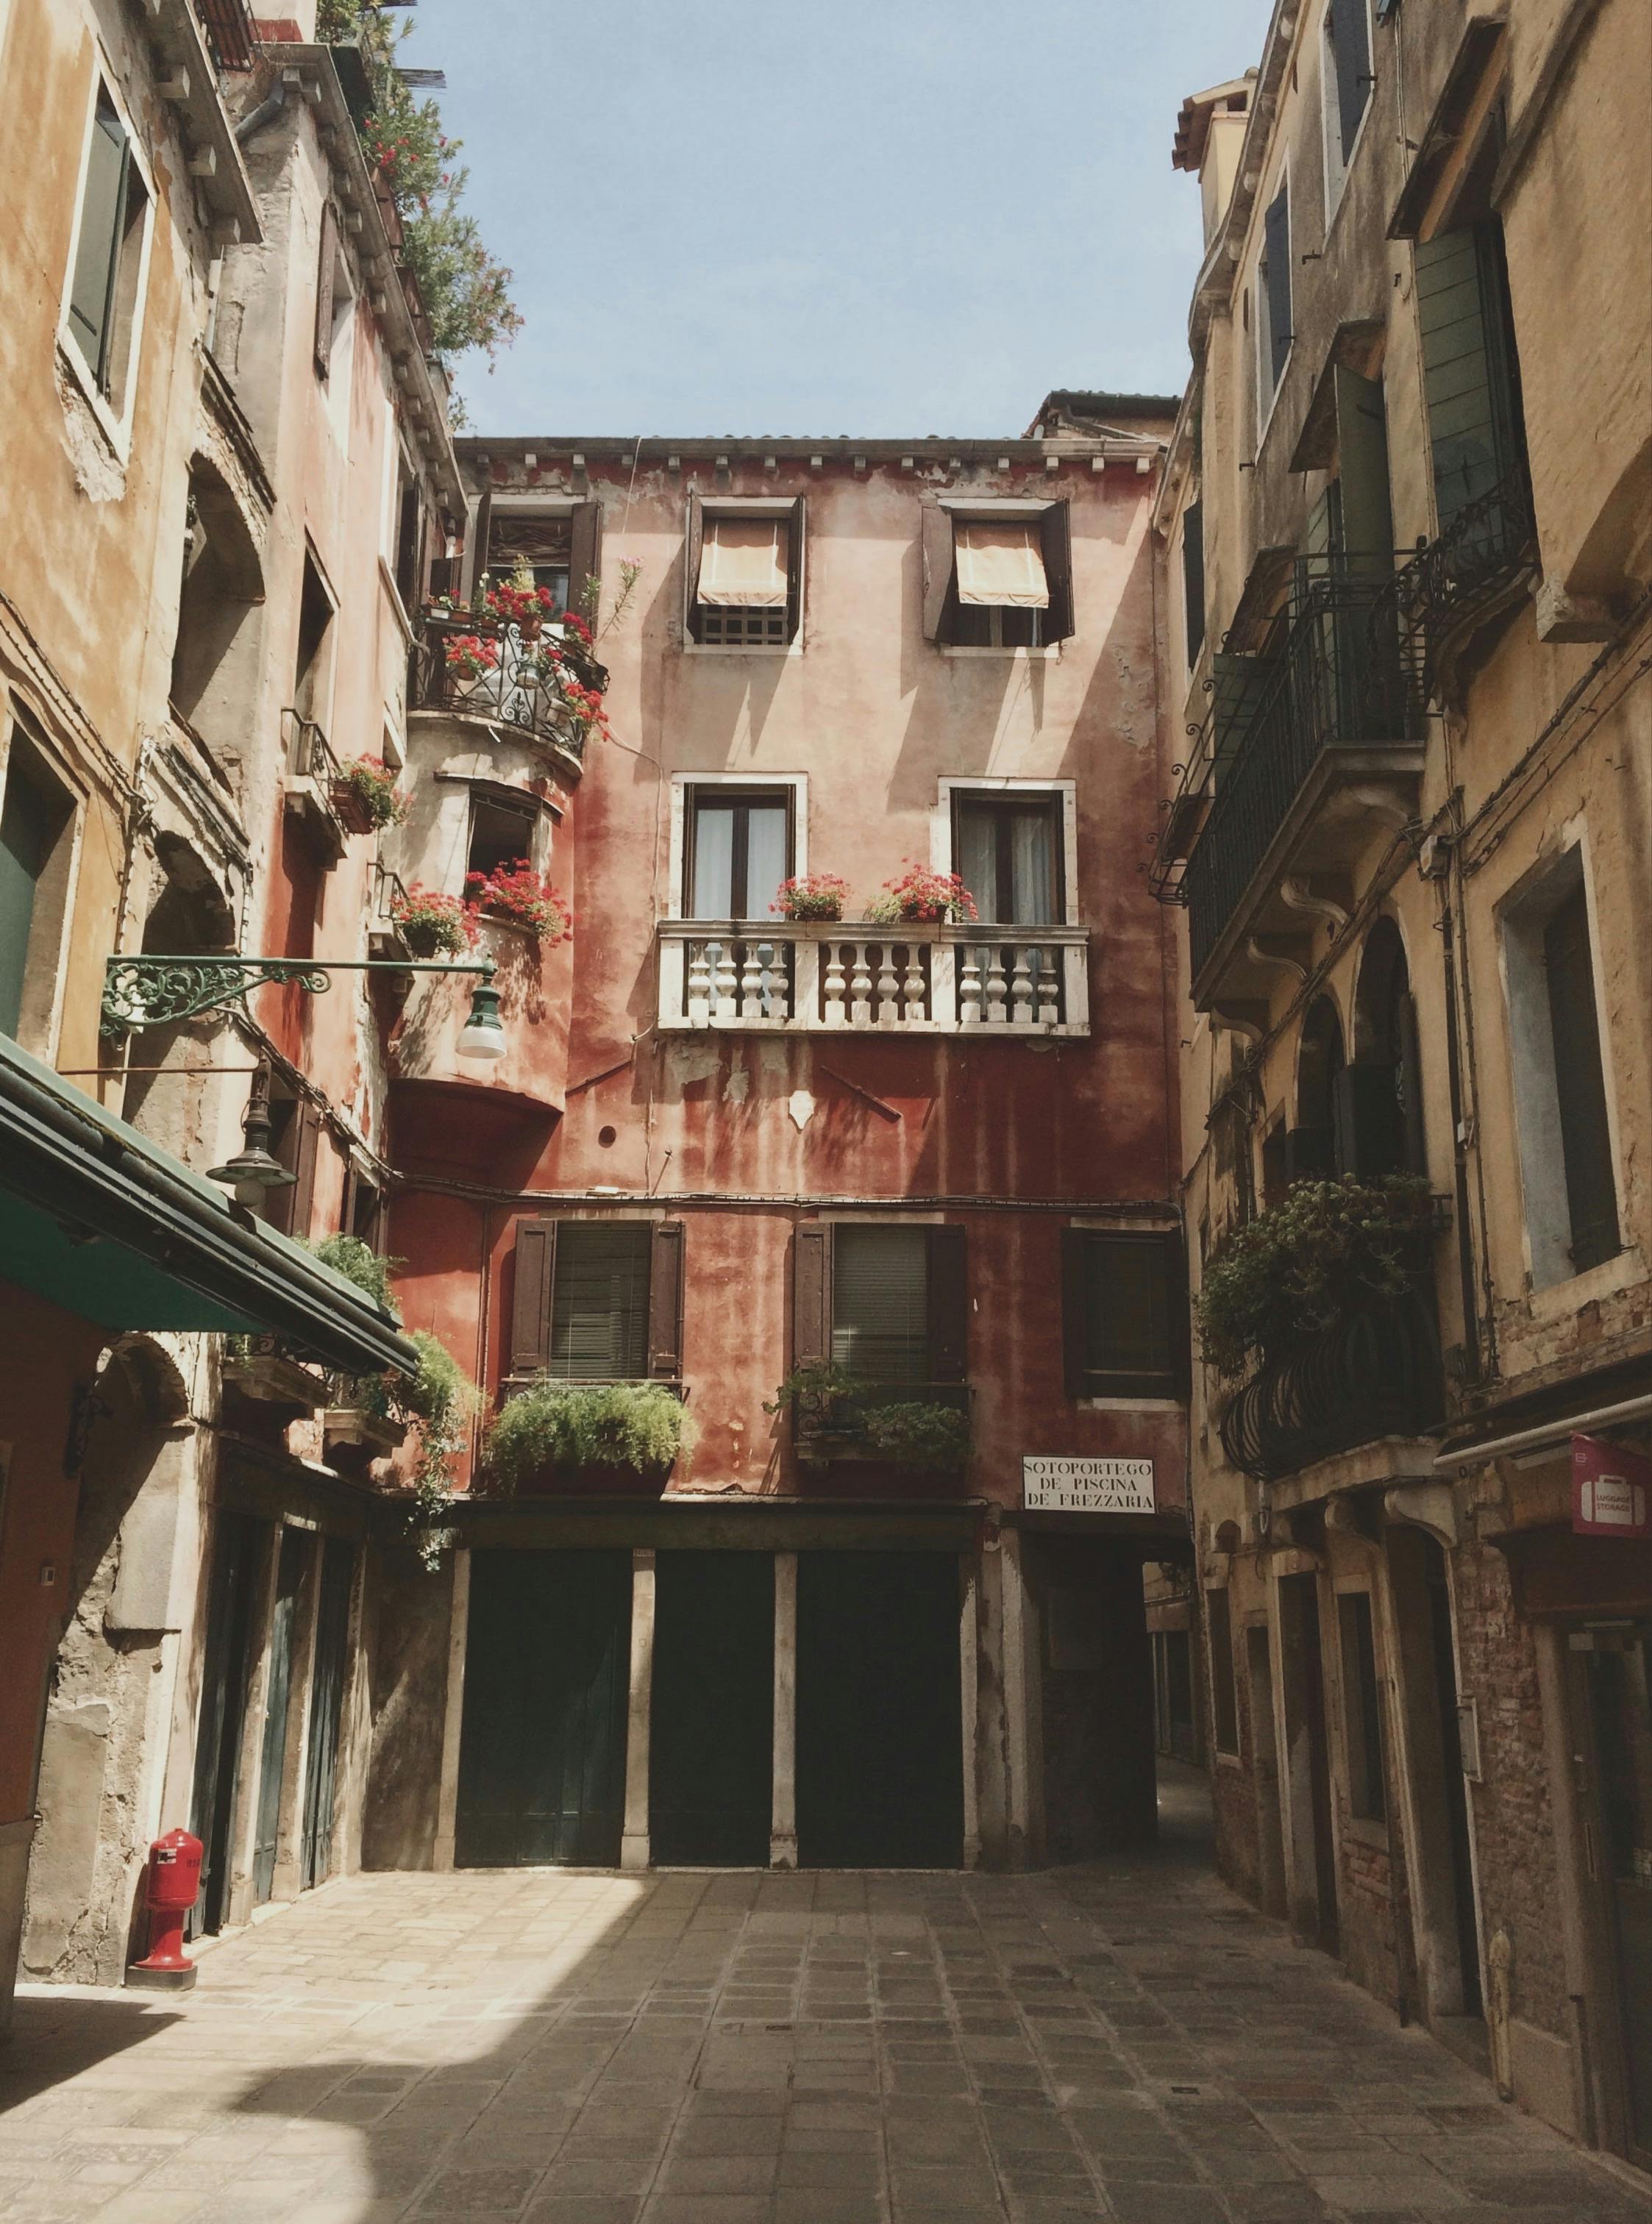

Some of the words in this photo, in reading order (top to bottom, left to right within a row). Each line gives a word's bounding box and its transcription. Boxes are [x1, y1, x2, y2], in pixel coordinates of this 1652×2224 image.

[1023, 1461, 1153, 1476] SOTOPORTEGO
[1040, 1477, 1061, 1490] DE
[1074, 1478, 1137, 1491] PISCINA
[1028, 1493, 1050, 1505] DE
[1060, 1494, 1153, 1508] FREZZARIA
